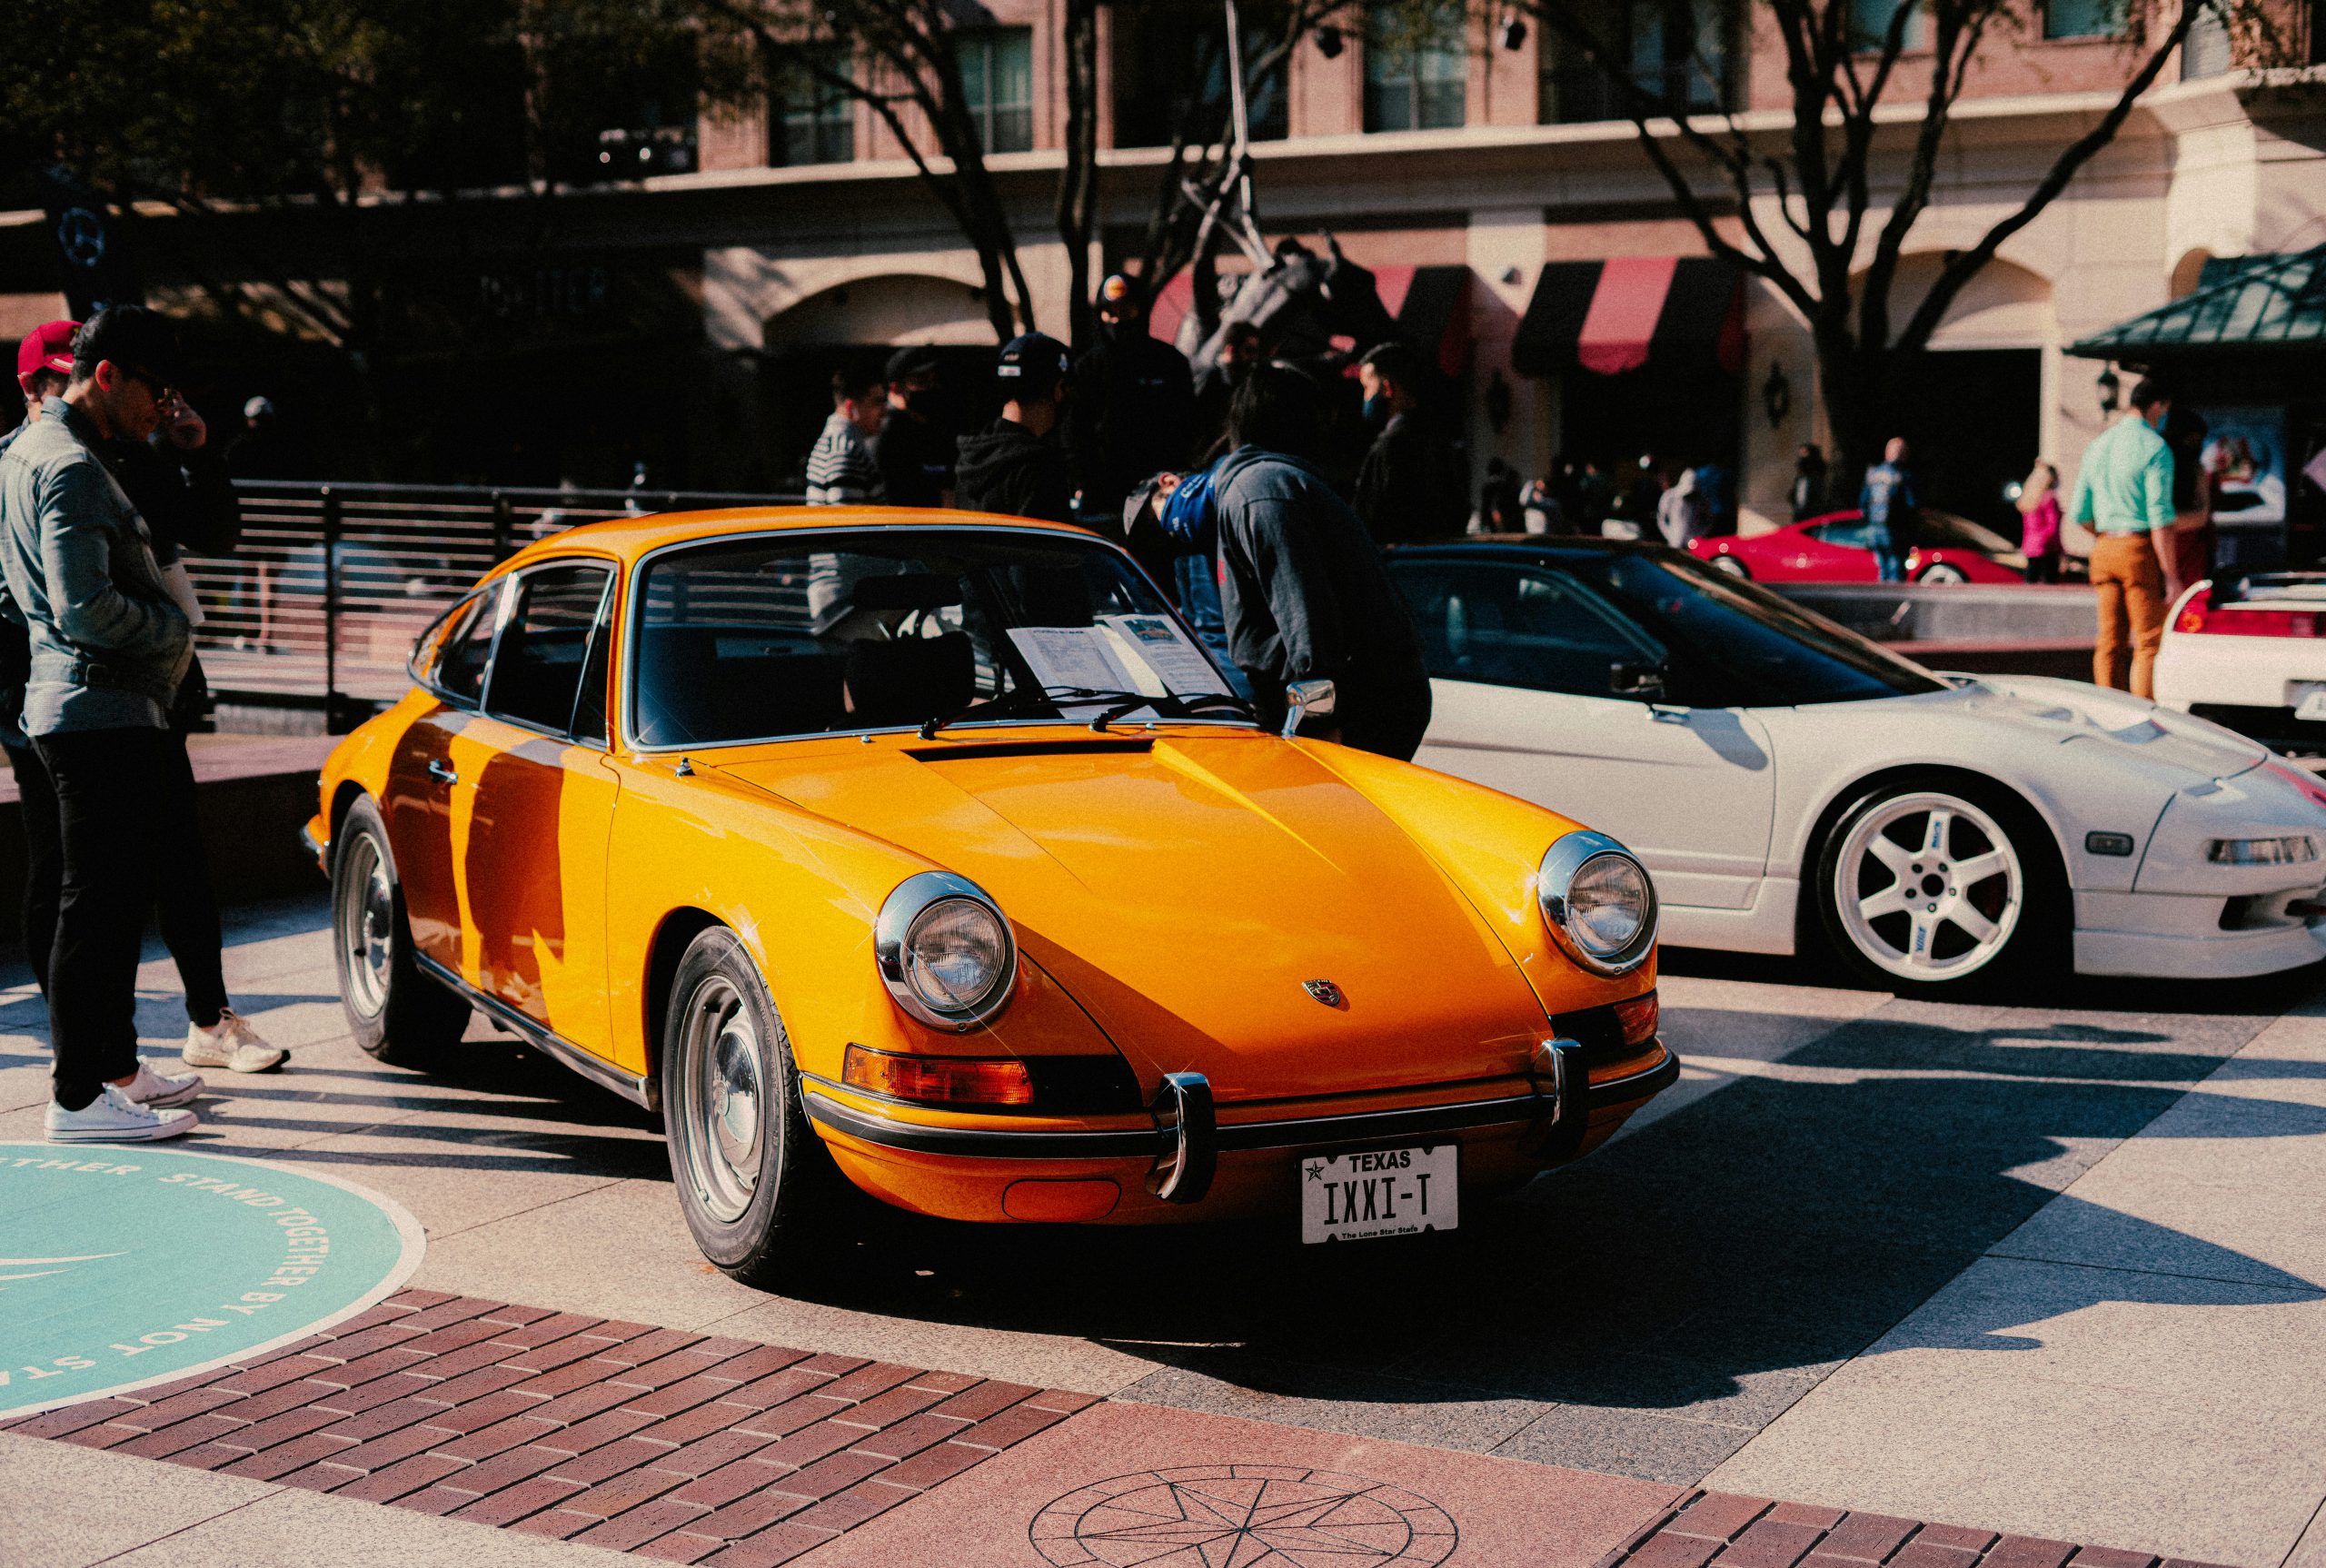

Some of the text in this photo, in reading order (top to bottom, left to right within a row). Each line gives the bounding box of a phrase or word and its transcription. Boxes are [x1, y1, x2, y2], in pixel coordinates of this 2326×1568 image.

[1349, 1150, 1411, 1173] TEXAS
[1323, 1174, 1431, 1226] IXXI-T
[0, 1156, 330, 1385] THER STAND TOGETHER BY NOT ST
